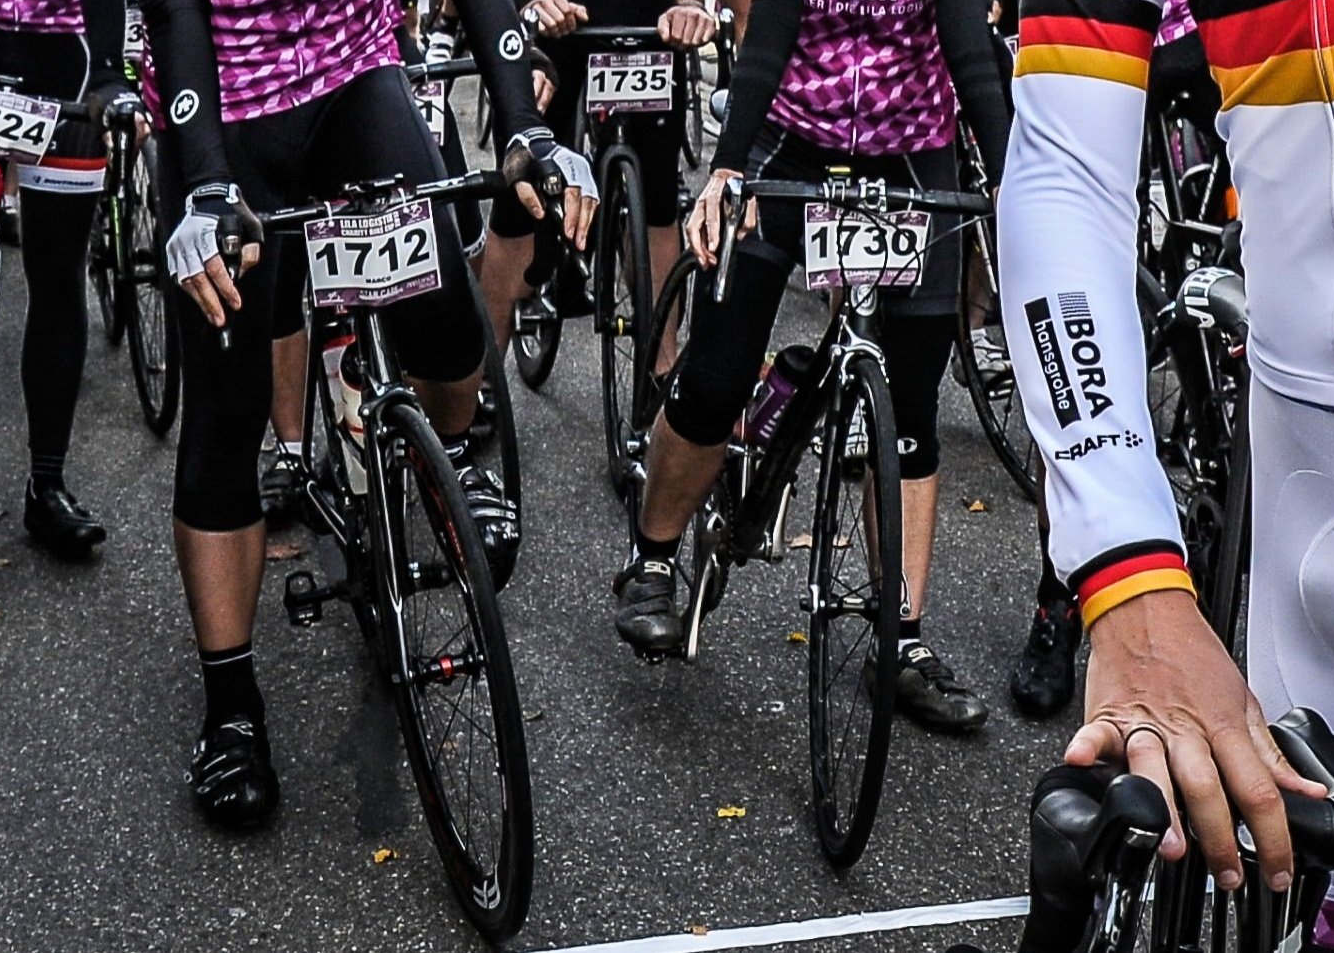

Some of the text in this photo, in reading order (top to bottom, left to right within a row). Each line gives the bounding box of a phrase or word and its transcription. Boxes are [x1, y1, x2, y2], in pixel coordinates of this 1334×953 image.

[592, 68, 667, 94] 1735
[315, 227, 430, 277] 1712
[810, 225, 919, 259] 1730
[1033, 319, 1071, 411] hansgrohe
[1063, 317, 1115, 421] BORA
[1054, 433, 1121, 462] CRAFT
